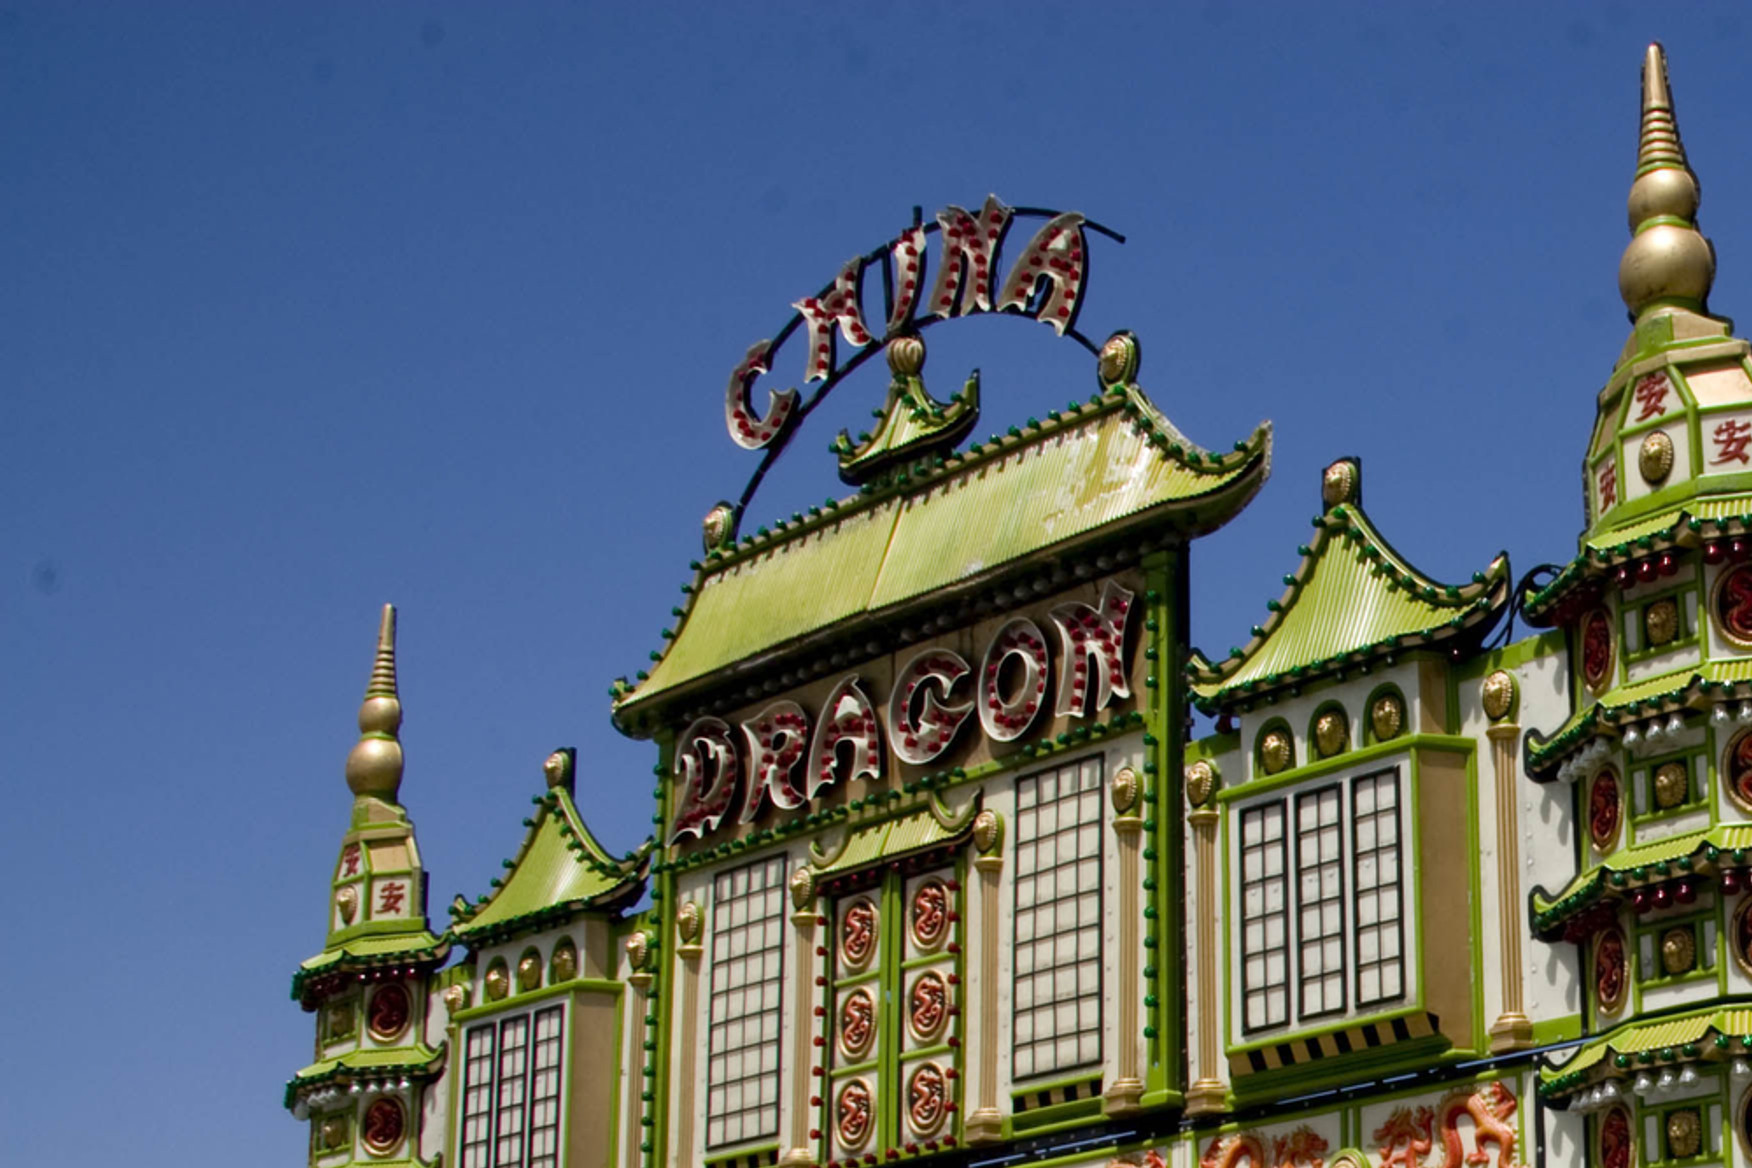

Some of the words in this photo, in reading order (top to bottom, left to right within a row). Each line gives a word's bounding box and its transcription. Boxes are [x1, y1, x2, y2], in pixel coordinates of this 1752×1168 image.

[726, 194, 1086, 450] CHINA
[1709, 419, 1752, 465] 安
[667, 580, 1135, 846] DRAGON
[375, 882, 405, 914] 安
